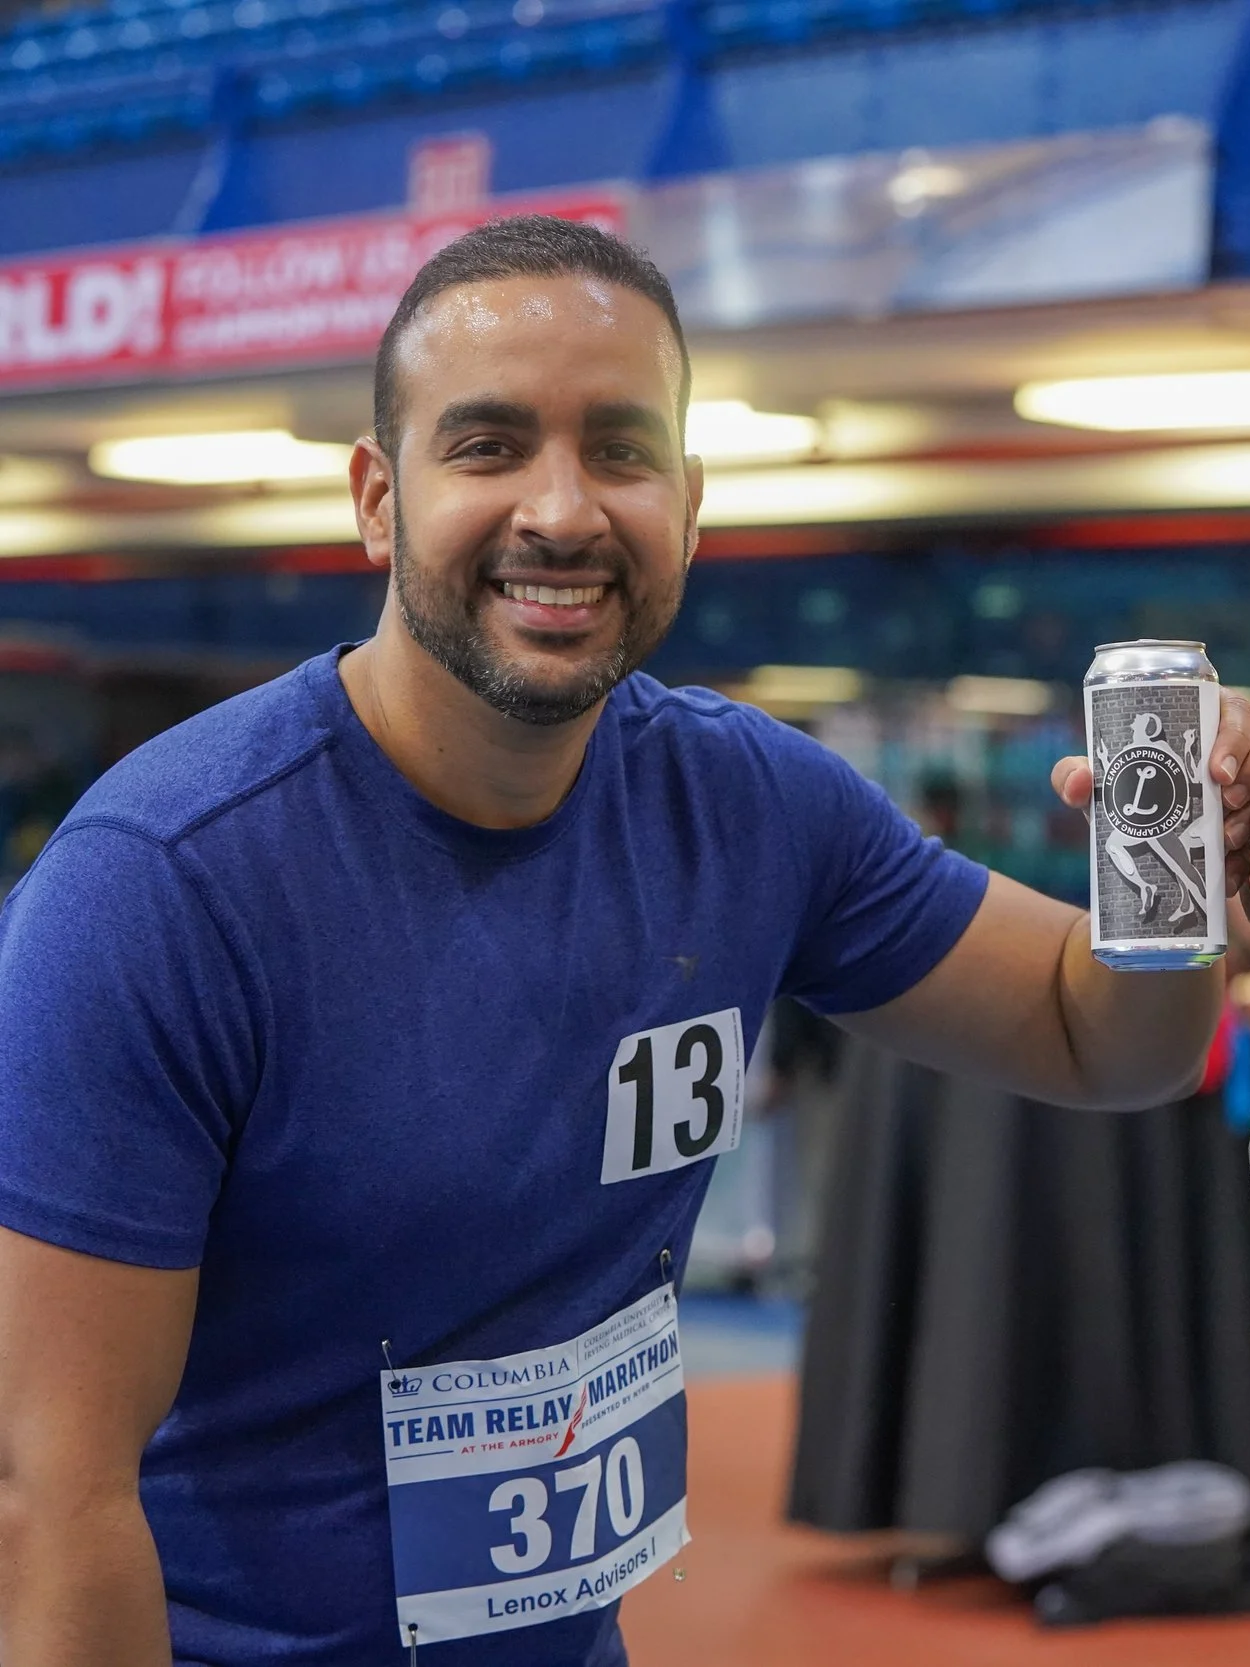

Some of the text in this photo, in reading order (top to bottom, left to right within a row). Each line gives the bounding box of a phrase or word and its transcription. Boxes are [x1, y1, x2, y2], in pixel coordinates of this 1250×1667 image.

[1106, 750, 1181, 786] LENOX LAPPING ALE
[1122, 766, 1158, 816] L
[1108, 804, 1184, 837] LENOX LAPPING ALE
[618, 1023, 725, 1171] 13
[583, 1321, 621, 1349] COLUMBIA
[584, 1340, 610, 1361] IRVING
[612, 1319, 647, 1345] MEDICAL
[387, 1330, 679, 1447] TEAM RELAY MARATHON
[432, 1357, 571, 1392] COLUMBIA
[581, 1400, 621, 1430] PRESENTED
[622, 1394, 631, 1405] BY
[461, 1431, 560, 1455] AT THE ARMORY
[488, 1436, 645, 1574] 370
[488, 1587, 569, 1619] Lenox
[575, 1547, 649, 1601] Advisors
